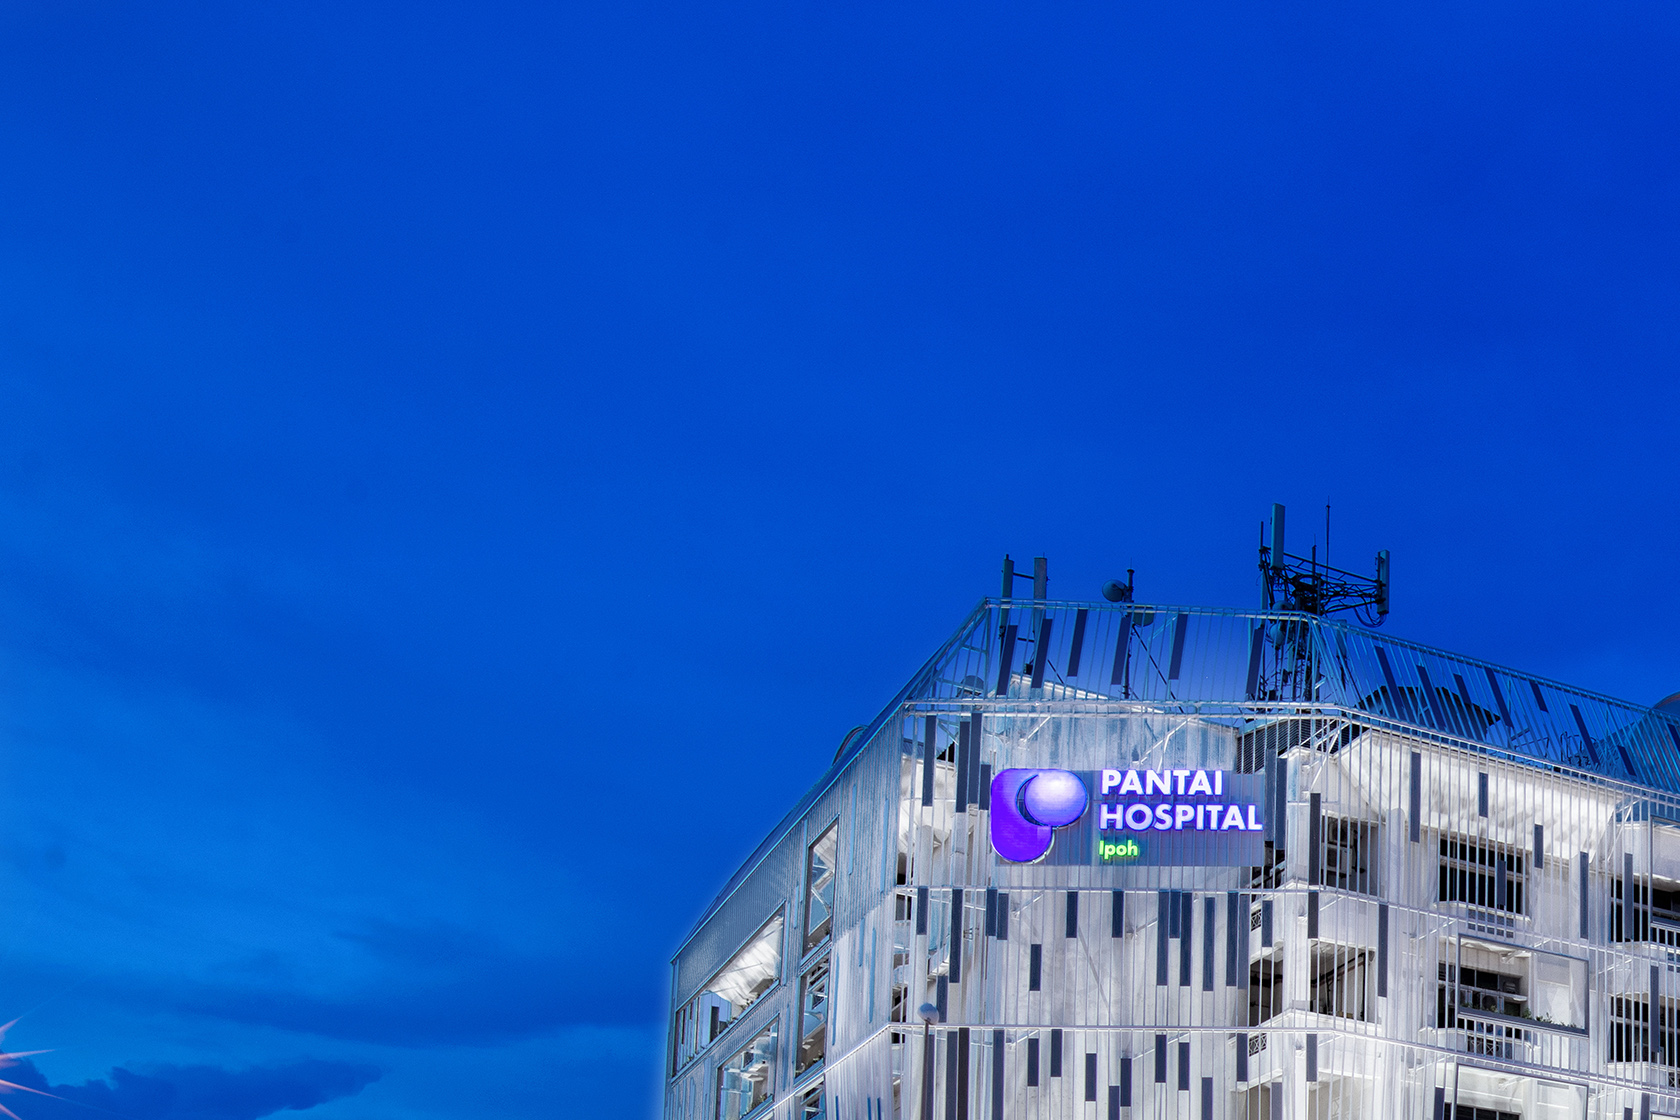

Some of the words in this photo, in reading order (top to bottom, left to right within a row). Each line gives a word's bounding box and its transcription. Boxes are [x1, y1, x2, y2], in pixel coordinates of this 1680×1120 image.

[1101, 768, 1223, 796] PANTAI
[1099, 803, 1264, 831] HOSPITAL
[1099, 839, 1139, 860] Ipoh
